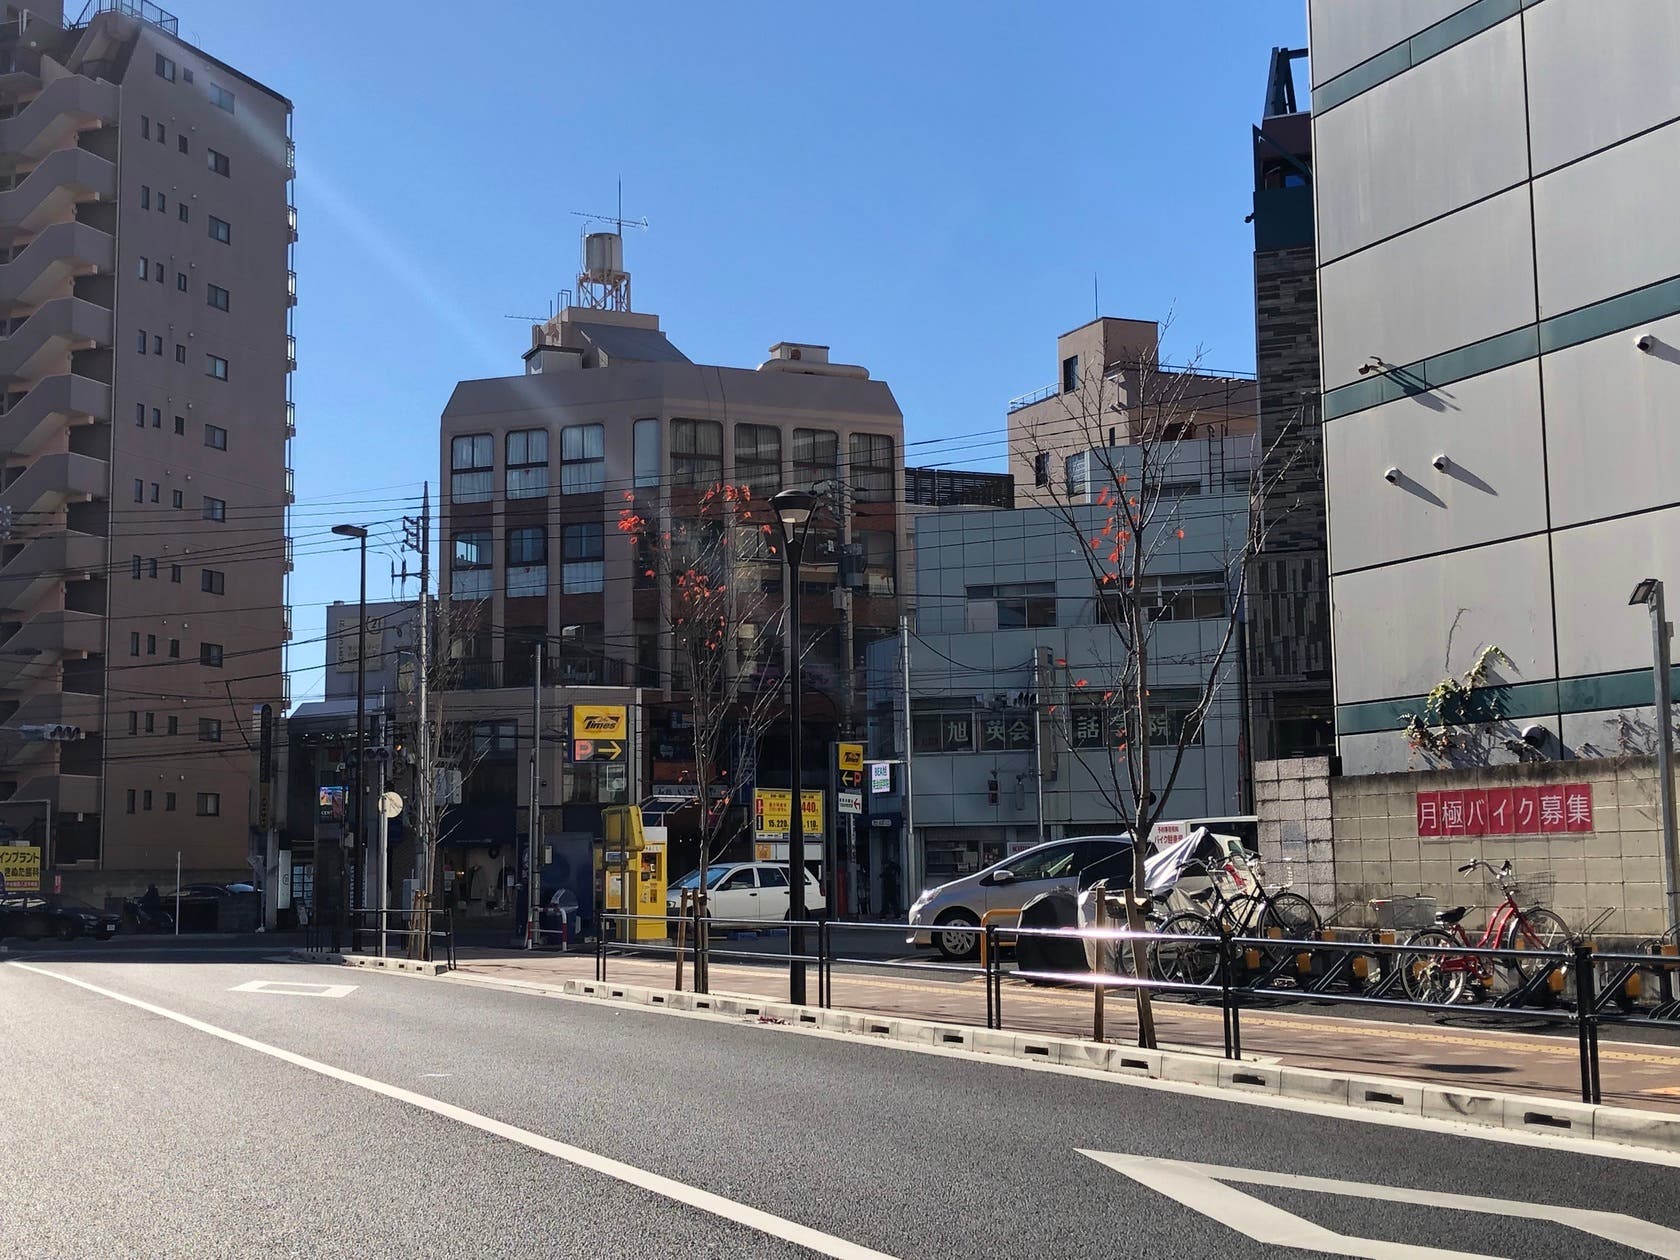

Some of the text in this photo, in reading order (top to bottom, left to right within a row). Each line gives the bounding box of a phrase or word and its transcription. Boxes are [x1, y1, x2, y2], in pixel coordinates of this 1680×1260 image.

[583, 715, 621, 730] Times
[948, 715, 1171, 743] 旭英会話院
[854, 772, 862, 787] P
[1419, 794, 1591, 829] 月極バイク募集
